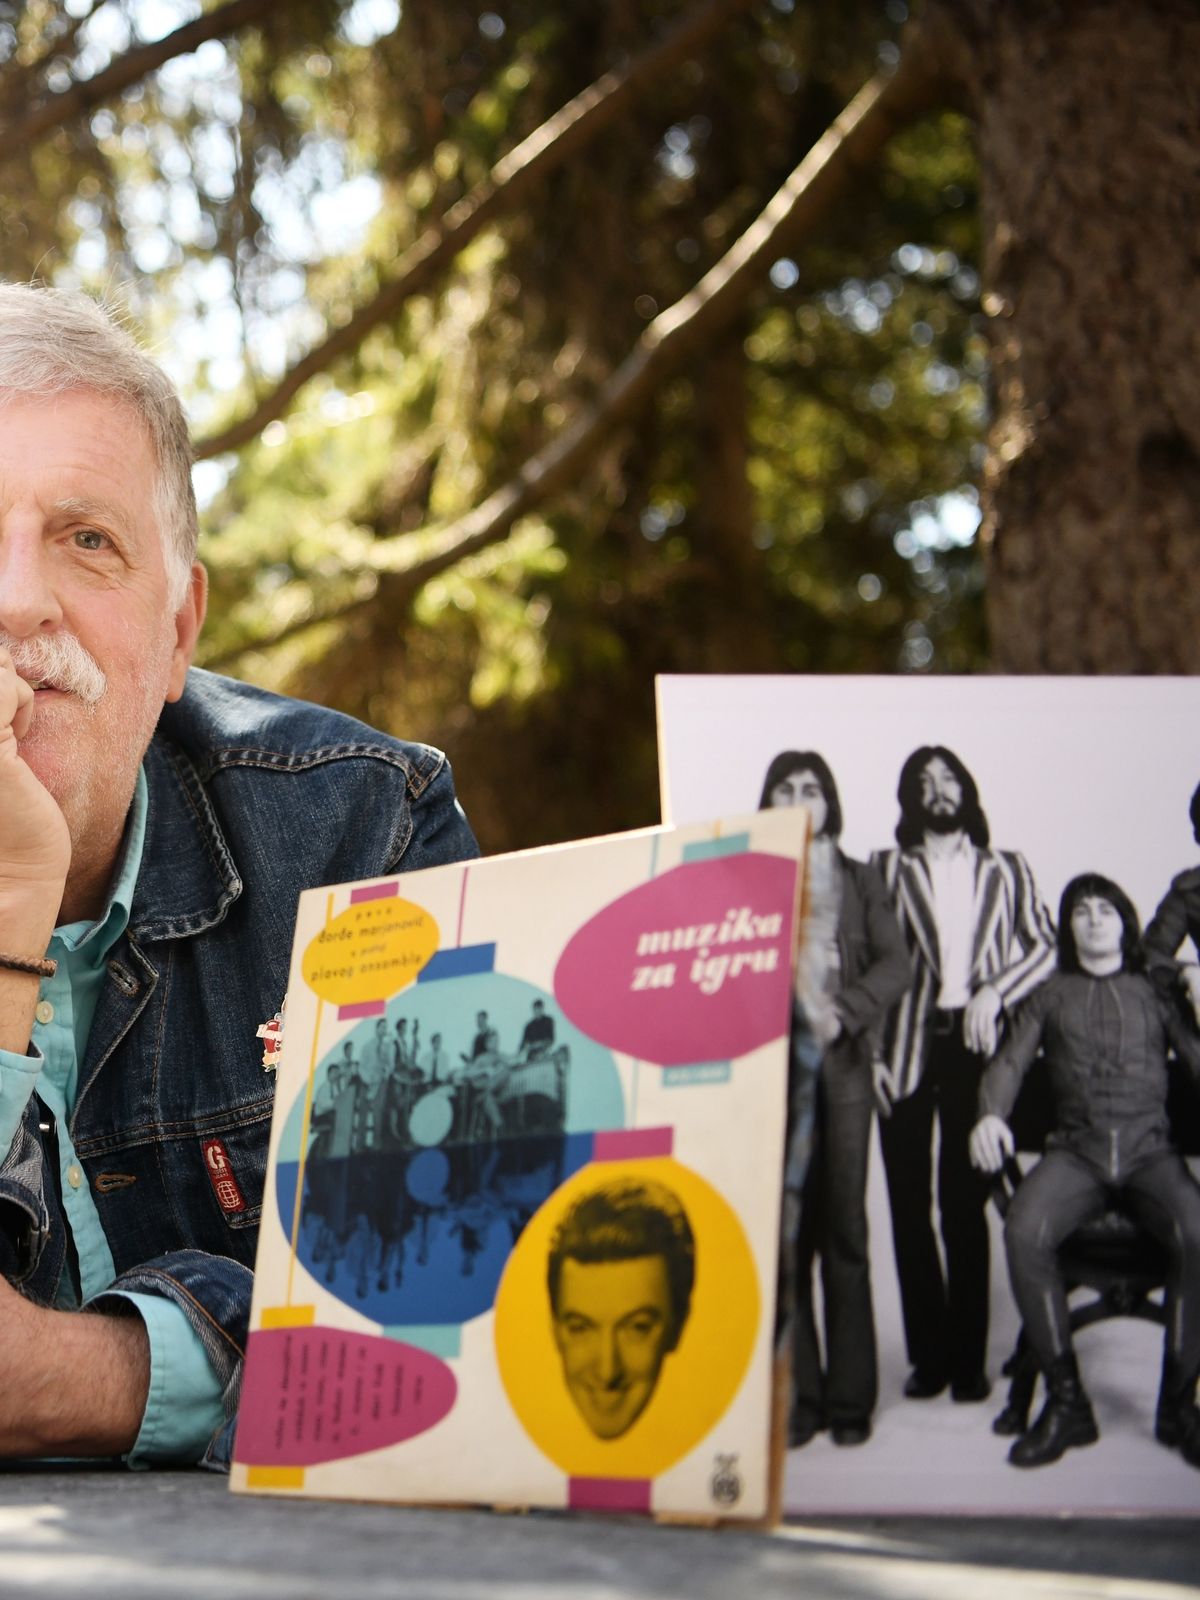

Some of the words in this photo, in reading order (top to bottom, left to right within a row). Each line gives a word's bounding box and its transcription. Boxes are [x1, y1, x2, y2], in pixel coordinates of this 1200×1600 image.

[637, 907, 783, 956] muzika
[630, 963, 676, 992] za
[689, 946, 779, 995] igru
[207, 1145, 225, 1169] G
